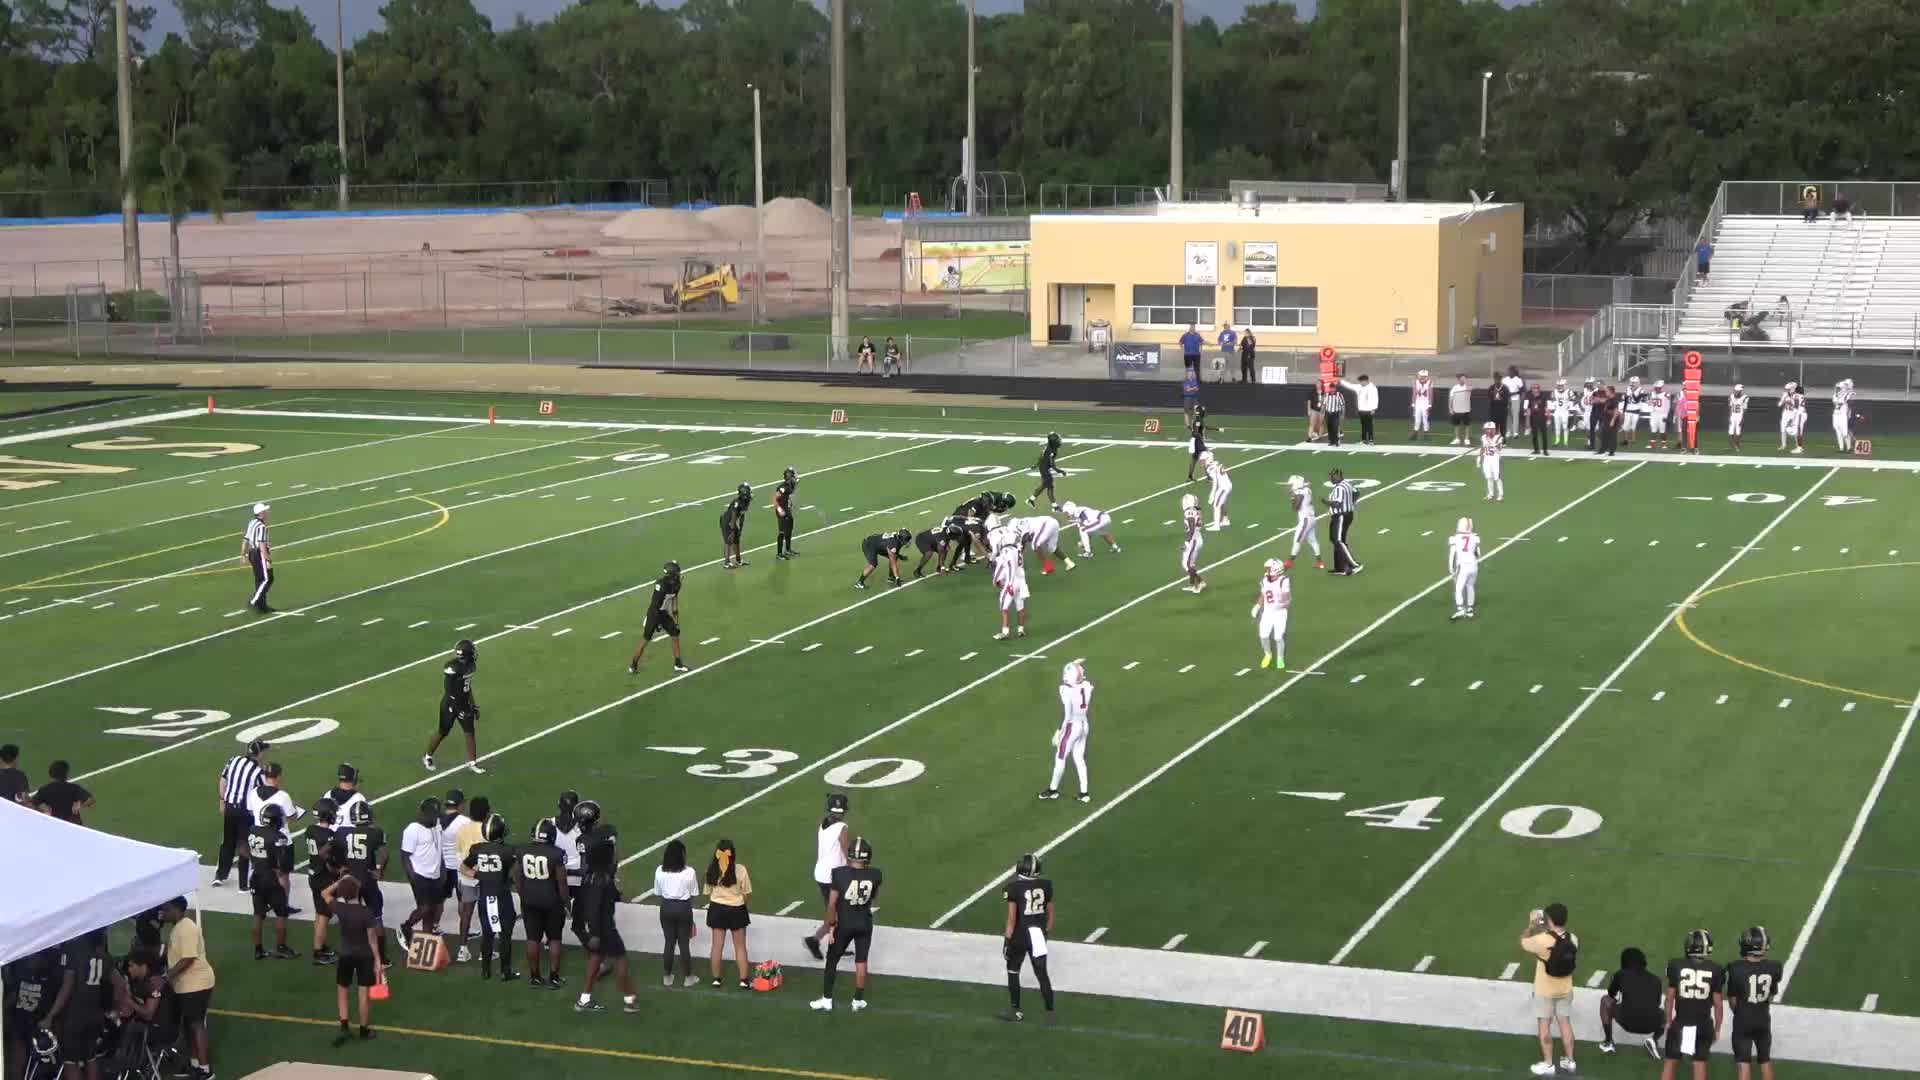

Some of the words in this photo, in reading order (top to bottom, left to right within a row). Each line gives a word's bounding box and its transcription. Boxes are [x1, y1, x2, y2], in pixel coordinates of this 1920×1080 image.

[541, 402, 550, 413] G
[833, 411, 843, 422] 10
[1146, 420, 1157, 431] 20
[1856, 440, 1870, 453] 40
[1462, 536, 1470, 552] 7
[1265, 590, 1275, 604] 2
[1080, 688, 1087, 709] 1
[346, 833, 368, 860] 15
[477, 854, 503, 872] 23
[522, 854, 550, 880] 60
[844, 880, 873, 906] 43
[1024, 888, 1046, 916] 12
[409, 937, 438, 967] 30
[87, 957, 103, 986] 11
[1680, 967, 1713, 1000] 25
[1747, 973, 1773, 1004] 13
[1225, 1015, 1258, 1047] 40
